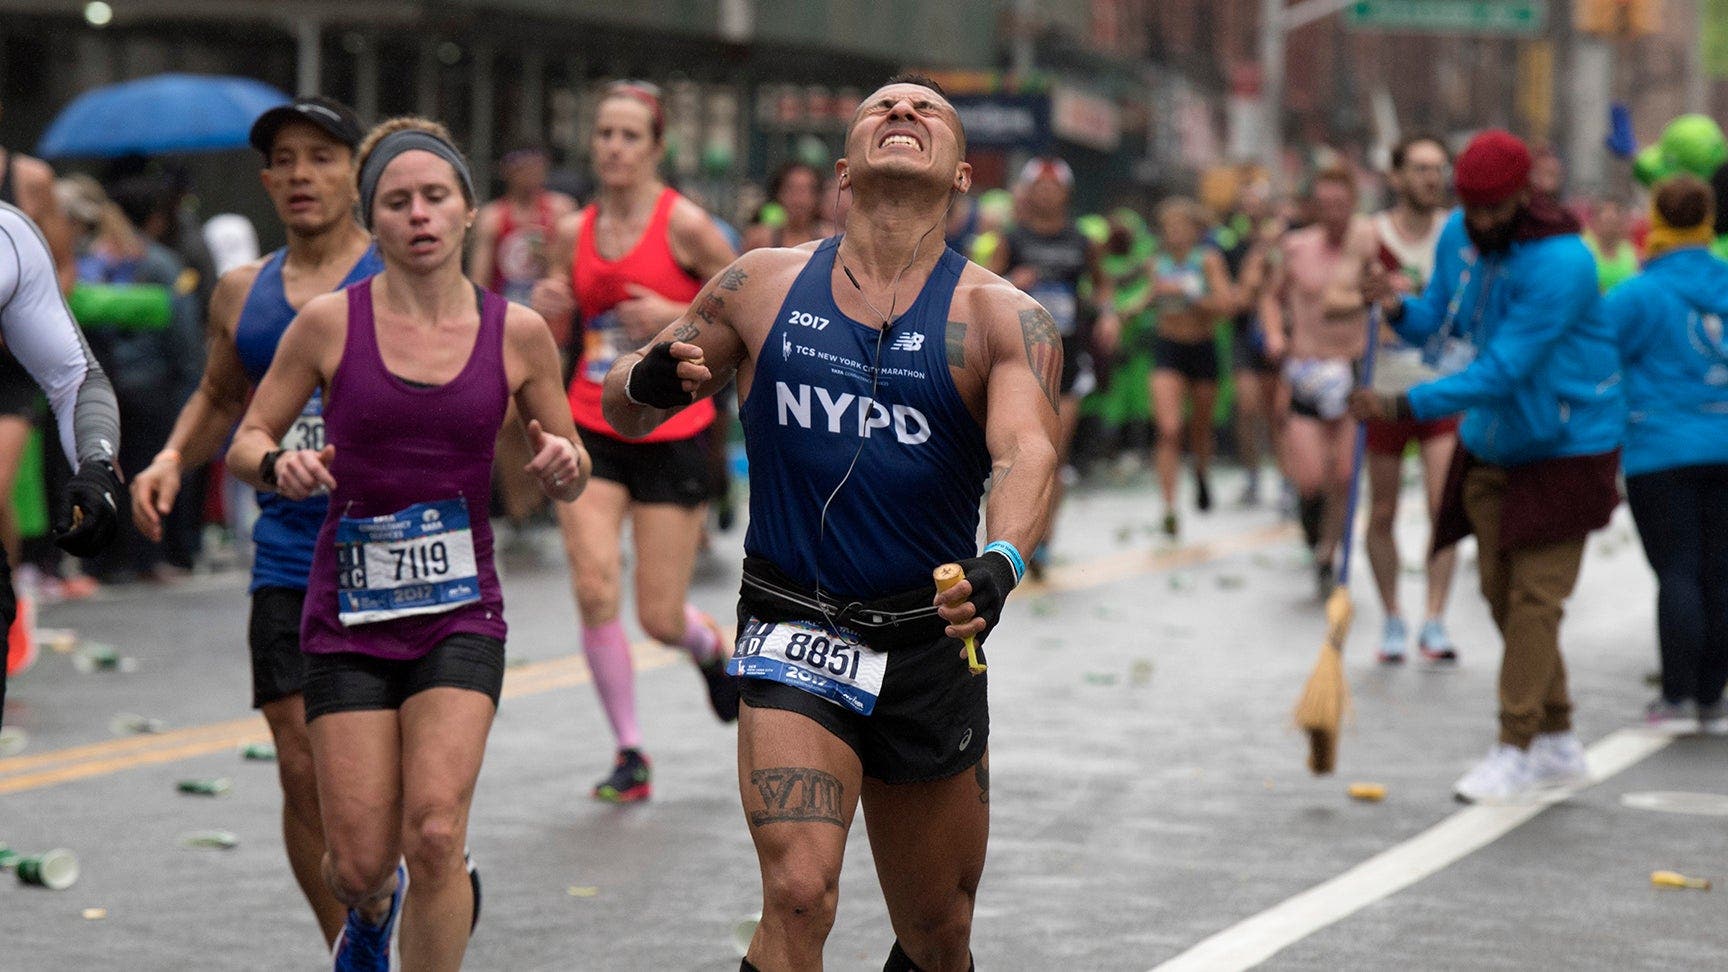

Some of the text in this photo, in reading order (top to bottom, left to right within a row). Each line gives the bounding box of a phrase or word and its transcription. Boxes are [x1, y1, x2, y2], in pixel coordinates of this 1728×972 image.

[788, 310, 830, 331] 2017
[795, 345, 926, 380] TCS NEW YORK CITY MARATHON
[831, 367, 844, 376] TATA
[775, 381, 931, 445] NYPD
[389, 540, 449, 581] 7119
[747, 637, 760, 655] D
[785, 632, 860, 680] 8851
[785, 665, 830, 687] 2017
